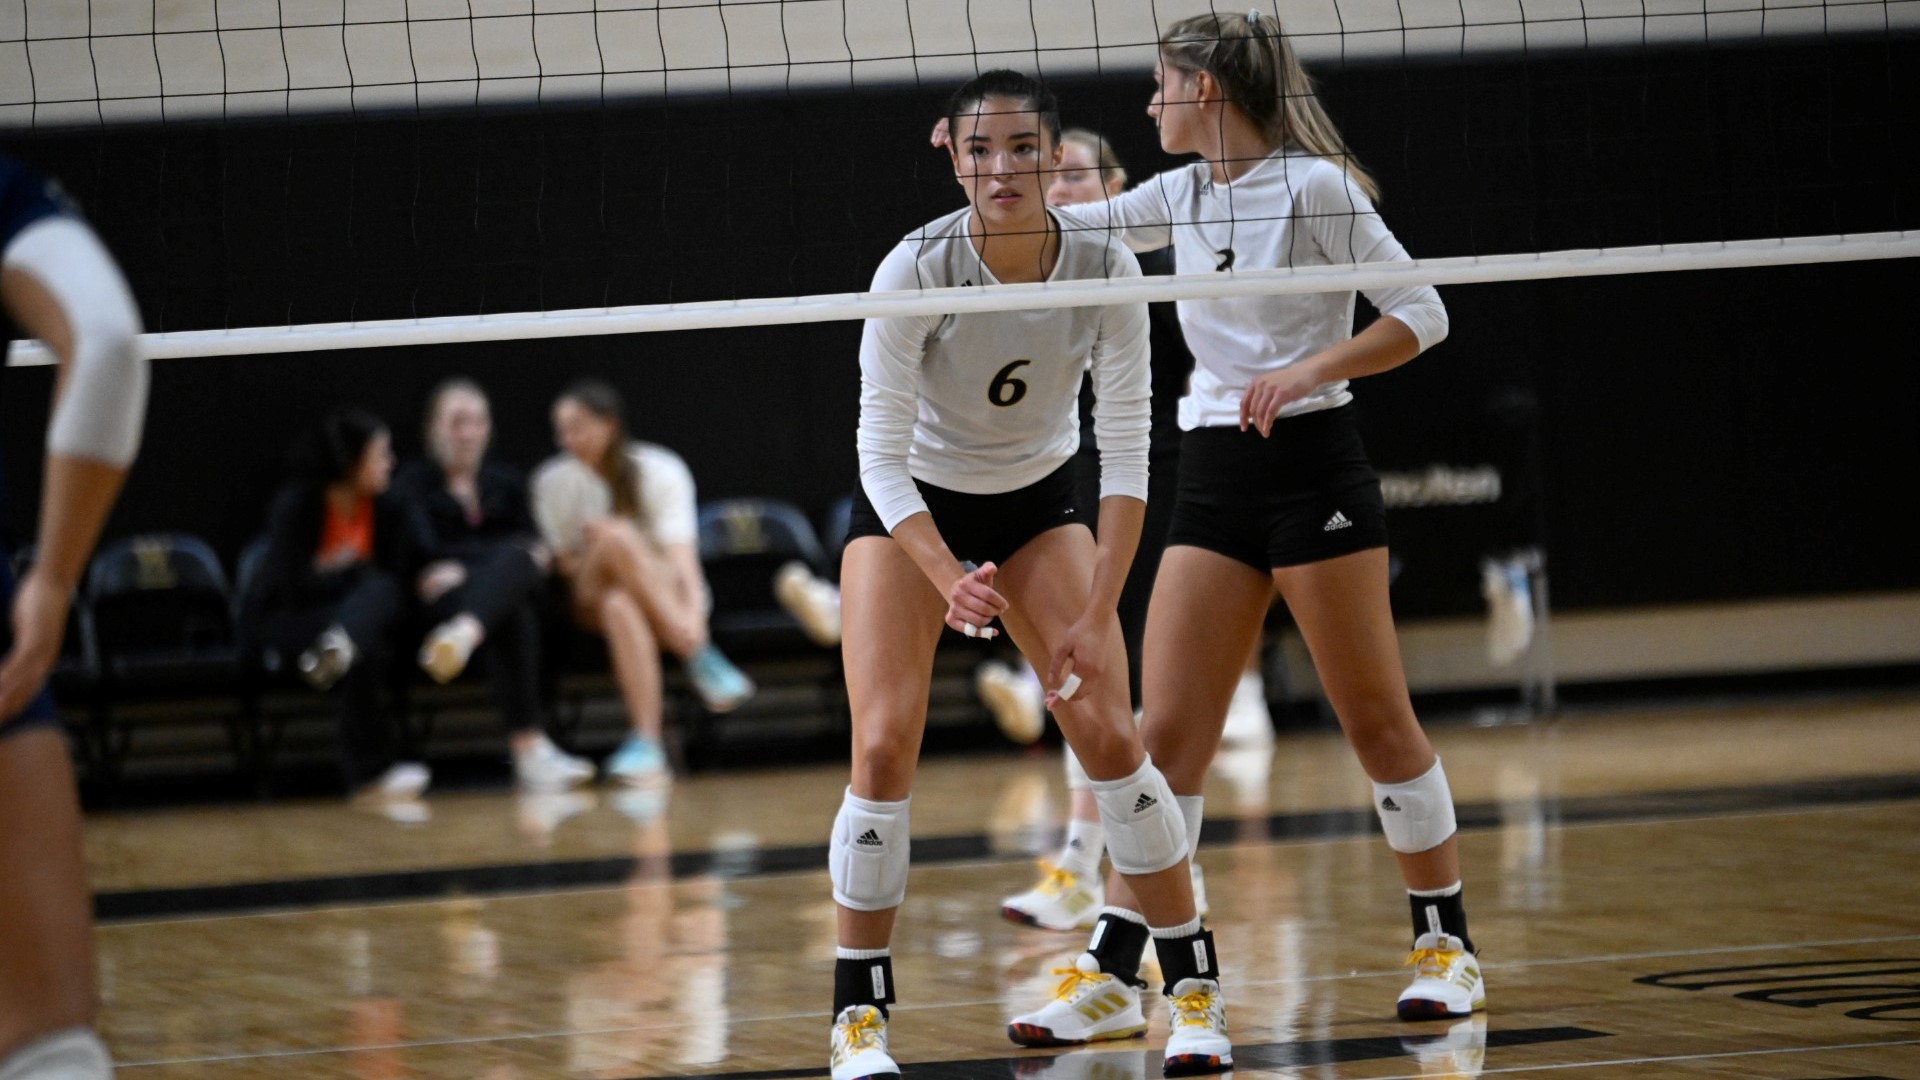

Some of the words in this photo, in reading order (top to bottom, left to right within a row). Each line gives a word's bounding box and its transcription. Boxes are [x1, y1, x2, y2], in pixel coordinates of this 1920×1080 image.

[988, 359, 1031, 407] 6
[1324, 520, 1353, 532] adidas
[1134, 798, 1158, 814] adidas
[856, 838, 884, 847] adidas
